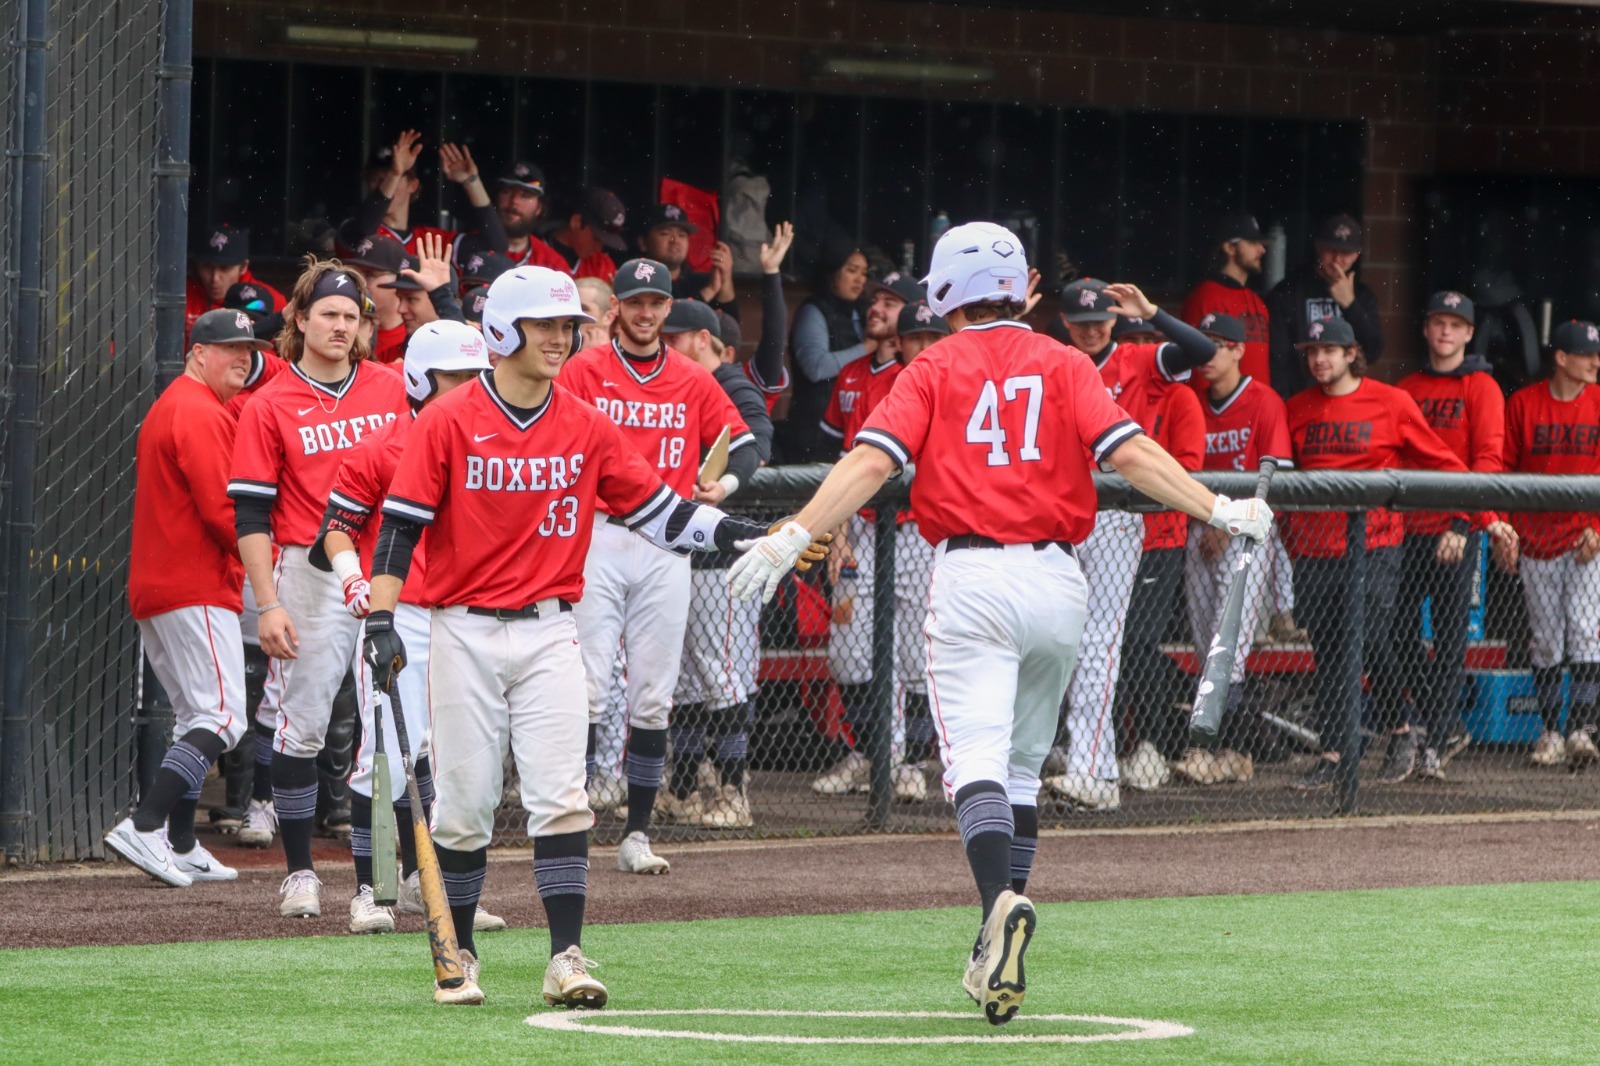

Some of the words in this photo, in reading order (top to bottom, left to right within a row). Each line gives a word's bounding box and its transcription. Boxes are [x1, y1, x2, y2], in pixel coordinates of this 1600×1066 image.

[595, 396, 686, 429] BOXERS
[965, 374, 1044, 466] 47
[1304, 421, 1373, 445] BOXER
[1533, 423, 1600, 446] BOXER
[657, 436, 686, 469] 18
[465, 453, 584, 492] BOXERS
